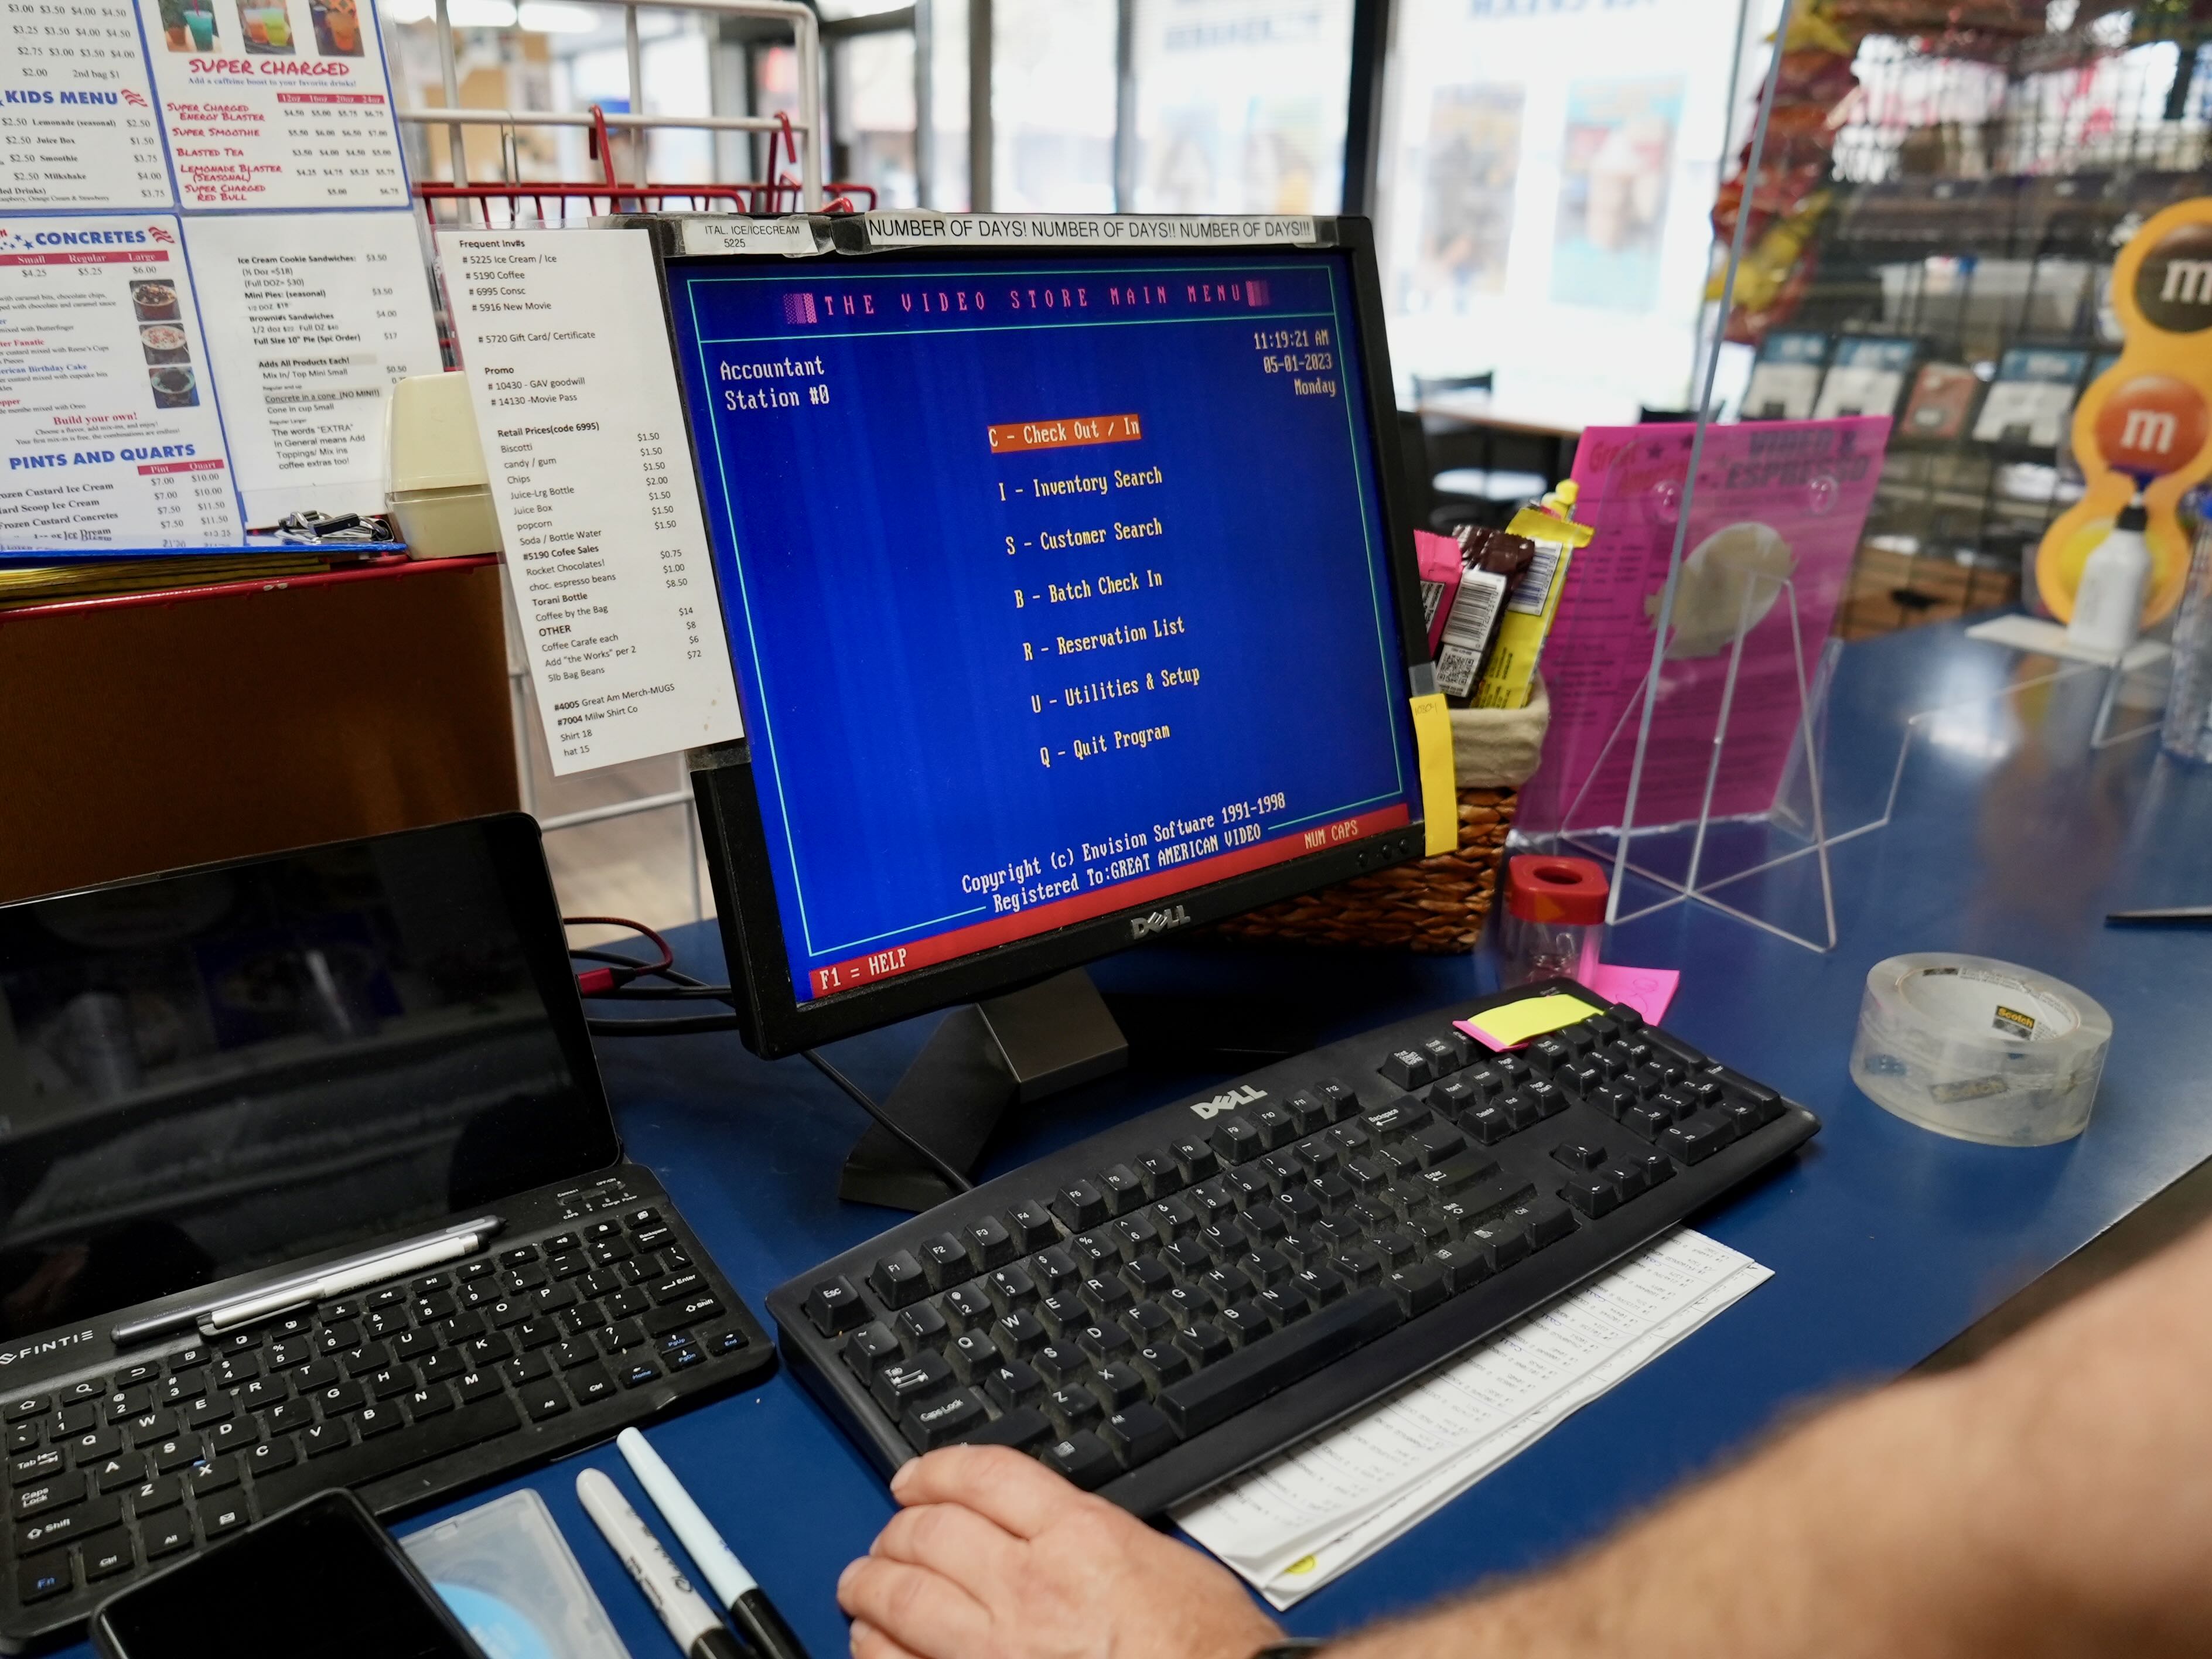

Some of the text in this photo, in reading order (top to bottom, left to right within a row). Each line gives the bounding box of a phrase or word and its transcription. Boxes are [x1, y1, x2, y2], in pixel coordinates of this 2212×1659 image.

[8, 4, 126, 17] $3.00 $3.50 $4.00 $4.50
[189, 59, 350, 76] SUPER CHARGED
[5, 90, 118, 104] KIDS MENU
[167, 103, 249, 112] SUPER CHARGED
[180, 113, 265, 121] ENERGY BLASTER
[172, 128, 260, 136] SUPER SMOOTHIE
[705, 224, 800, 235] ITAL. ICE/ICECREAM
[869, 220, 1310, 238] NUMBER OF DAYS! NUMBER OF DAYS!! NUMBER OF DAYS!!!
[35, 231, 146, 245] CONCRETES
[459, 239, 525, 250] Frequent Inv#s
[724, 238, 746, 248] 5225
[18, 253, 155, 264] Small Regular Large
[470, 254, 557, 264] 5225 Ice Cream Ice
[22, 266, 156, 278] $4.25 $5.25 $6.00
[473, 271, 525, 280] 5190 Coffee
[2160, 260, 2212, 305] m
[479, 302, 552, 311] 5916 New Movie
[825, 284, 1241, 316] THE VIDEO STORE MAIN MENU
[486, 330, 596, 343] 5720 Gift Card/ Certificate
[1254, 329, 1329, 350] 11:19:21 AM
[293, 358, 327, 367] Products
[721, 356, 825, 380] Accountant
[1263, 354, 1333, 373] 05-01-2023
[484, 366, 514, 375] Promo
[1294, 378, 1336, 397] Monday
[725, 384, 830, 411] Station #0
[53, 412, 138, 426] Build your own!
[498, 422, 600, 438] Retail Prices(code 6995)
[637, 432, 660, 442] $1.50
[988, 417, 1139, 447] C Check Out In
[2120, 409, 2177, 454] m
[501, 443, 533, 453] Biscotti
[9, 443, 196, 470] PINTS AND QUARTS
[150, 462, 216, 474] Pint Quart
[279, 461, 304, 470] coffee
[192, 473, 220, 483] $10.00
[999, 466, 1162, 501] I Inventory Search
[1005, 517, 1162, 555] S Customer Search
[523, 544, 599, 561] #5190 Cofee Sales
[660, 549, 682, 559] $0.75
[1014, 569, 1162, 608] B Batch Check In
[532, 592, 588, 606] Torani Bottle
[538, 625, 572, 637] OTHER
[1023, 616, 1184, 661] R Reservation List
[1032, 667, 1200, 713] U Utilities & Setup
[554, 684, 675, 711] #4005 Great Am Merch-MUGS
[564, 745, 590, 757] hat 15
[1040, 724, 1170, 768] Q Quit Program
[1304, 820, 1359, 849] NUM CAPS
[961, 792, 1286, 894] Copyright (c) Envision Software 1991-1998
[992, 822, 1261, 913] Registered To:GREAT AMERICAN VIDEO
[1130, 904, 1191, 939] DELL
[820, 967, 841, 990] F1
[869, 948, 907, 976] HELP
[1997, 1008, 2034, 1028] Scotch
[1326, 1084, 1339, 1093] F12
[1190, 1084, 1268, 1120] DELL
[1368, 1108, 1399, 1123] Backspace
[1069, 1189, 1081, 1199] F5
[639, 1228, 667, 1239] Backspace
[676, 1274, 696, 1284] Enter
[822, 1288, 842, 1299] Esc
[697, 1298, 714, 1308] Shift
[19, 1330, 94, 1359] FINTIE
[668, 1336, 686, 1347] PgUp
[589, 1383, 603, 1392] Ctrl
[920, 1398, 963, 1421] Caps Lock
[18, 1458, 36, 1470] Tab
